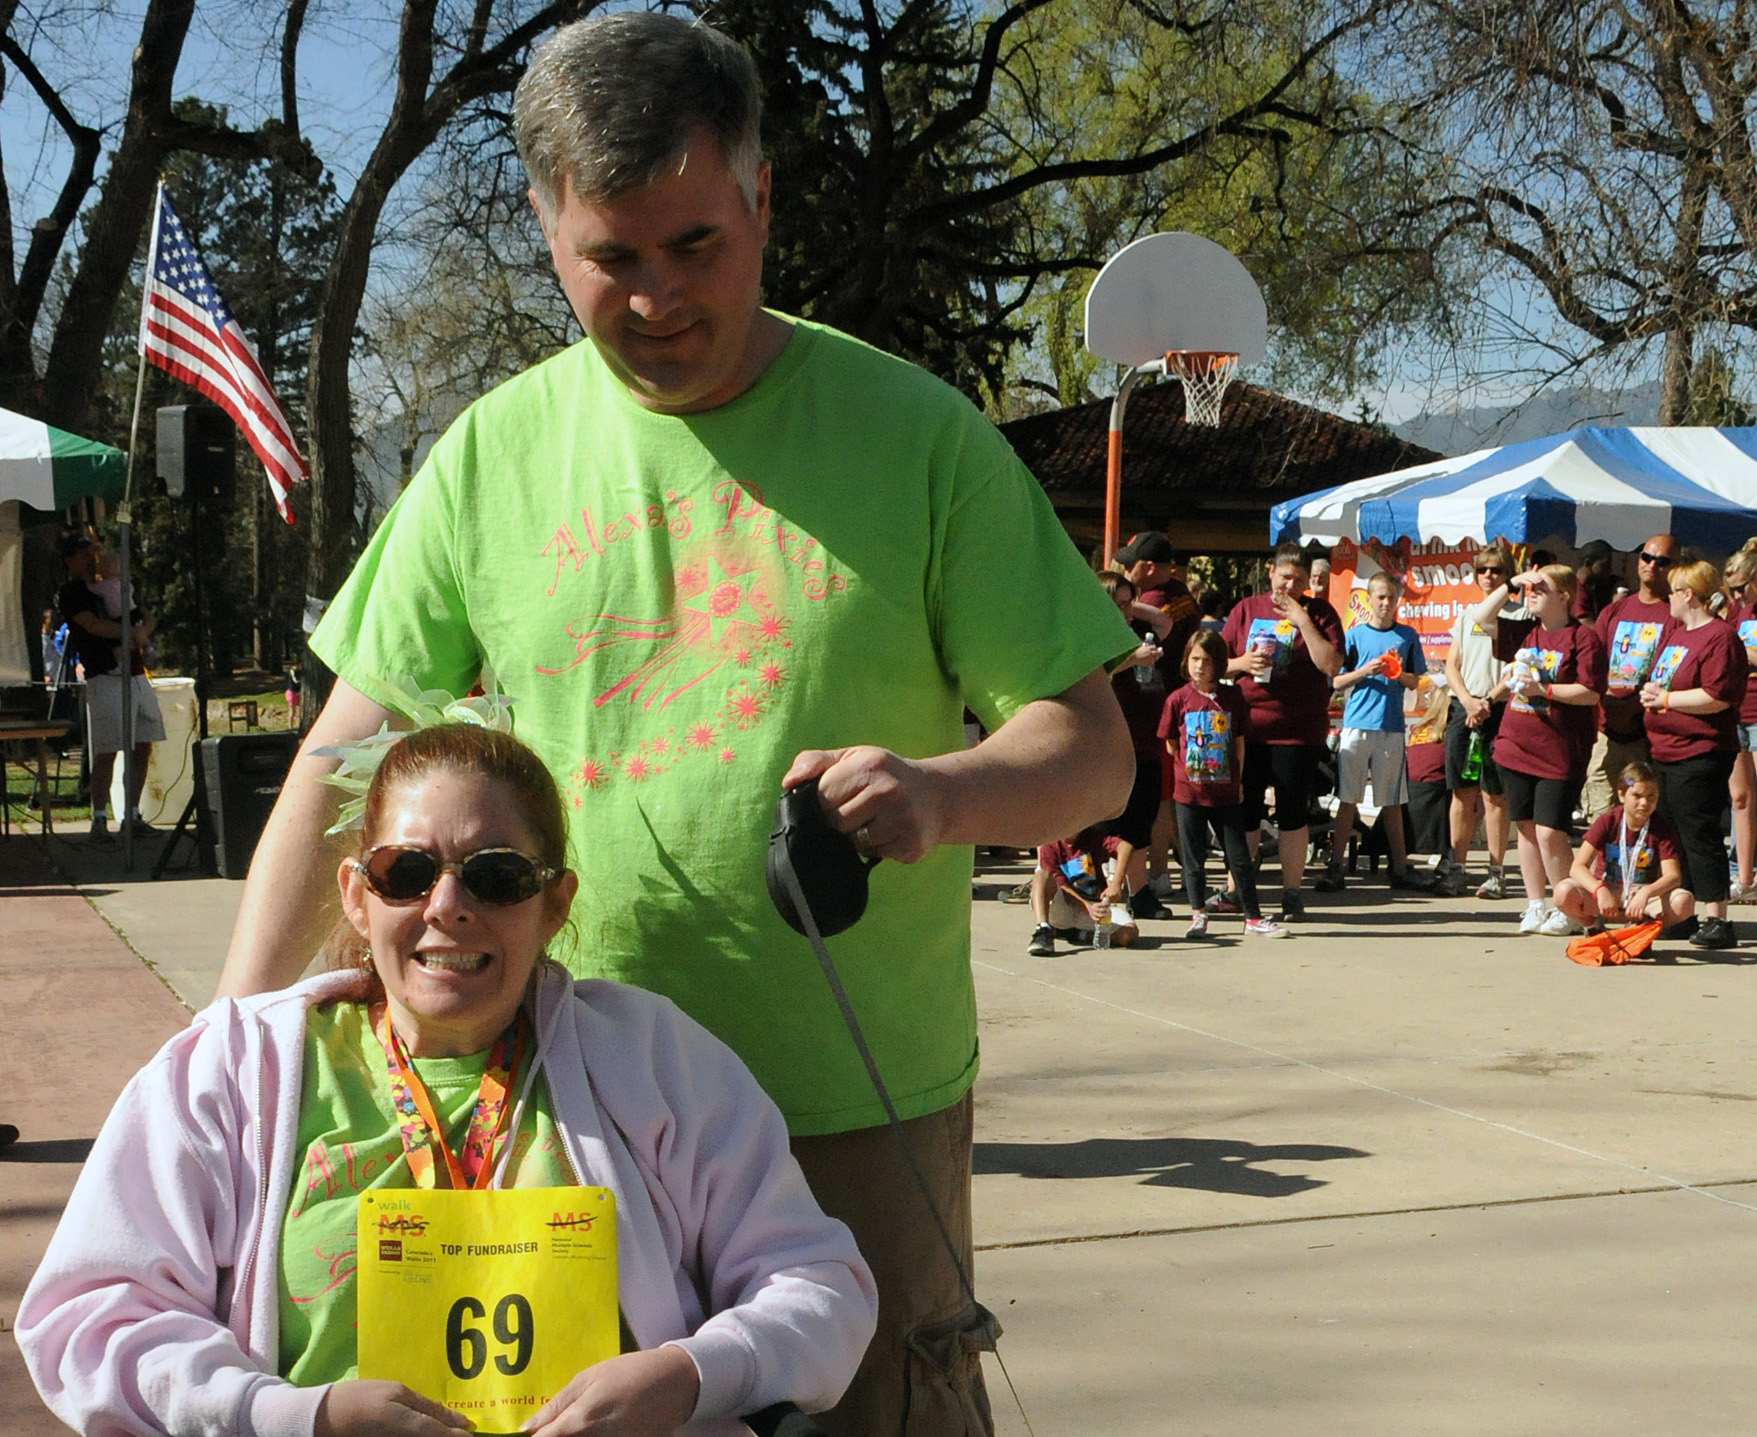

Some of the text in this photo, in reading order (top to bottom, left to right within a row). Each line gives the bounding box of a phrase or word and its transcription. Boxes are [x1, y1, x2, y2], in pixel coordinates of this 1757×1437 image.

[541, 480, 846, 599] Alexa's Pixies
[1411, 562, 1474, 588] smoo
[1398, 601, 1450, 620] chewing
[378, 1199, 411, 1211] walk
[378, 1214, 425, 1237] MS
[551, 1212, 592, 1232] MS
[441, 1242, 539, 1256] TOP FUNDRAISER
[445, 1294, 535, 1380] 69
[447, 1400, 485, 1409] create
[501, 1396, 535, 1406] world
